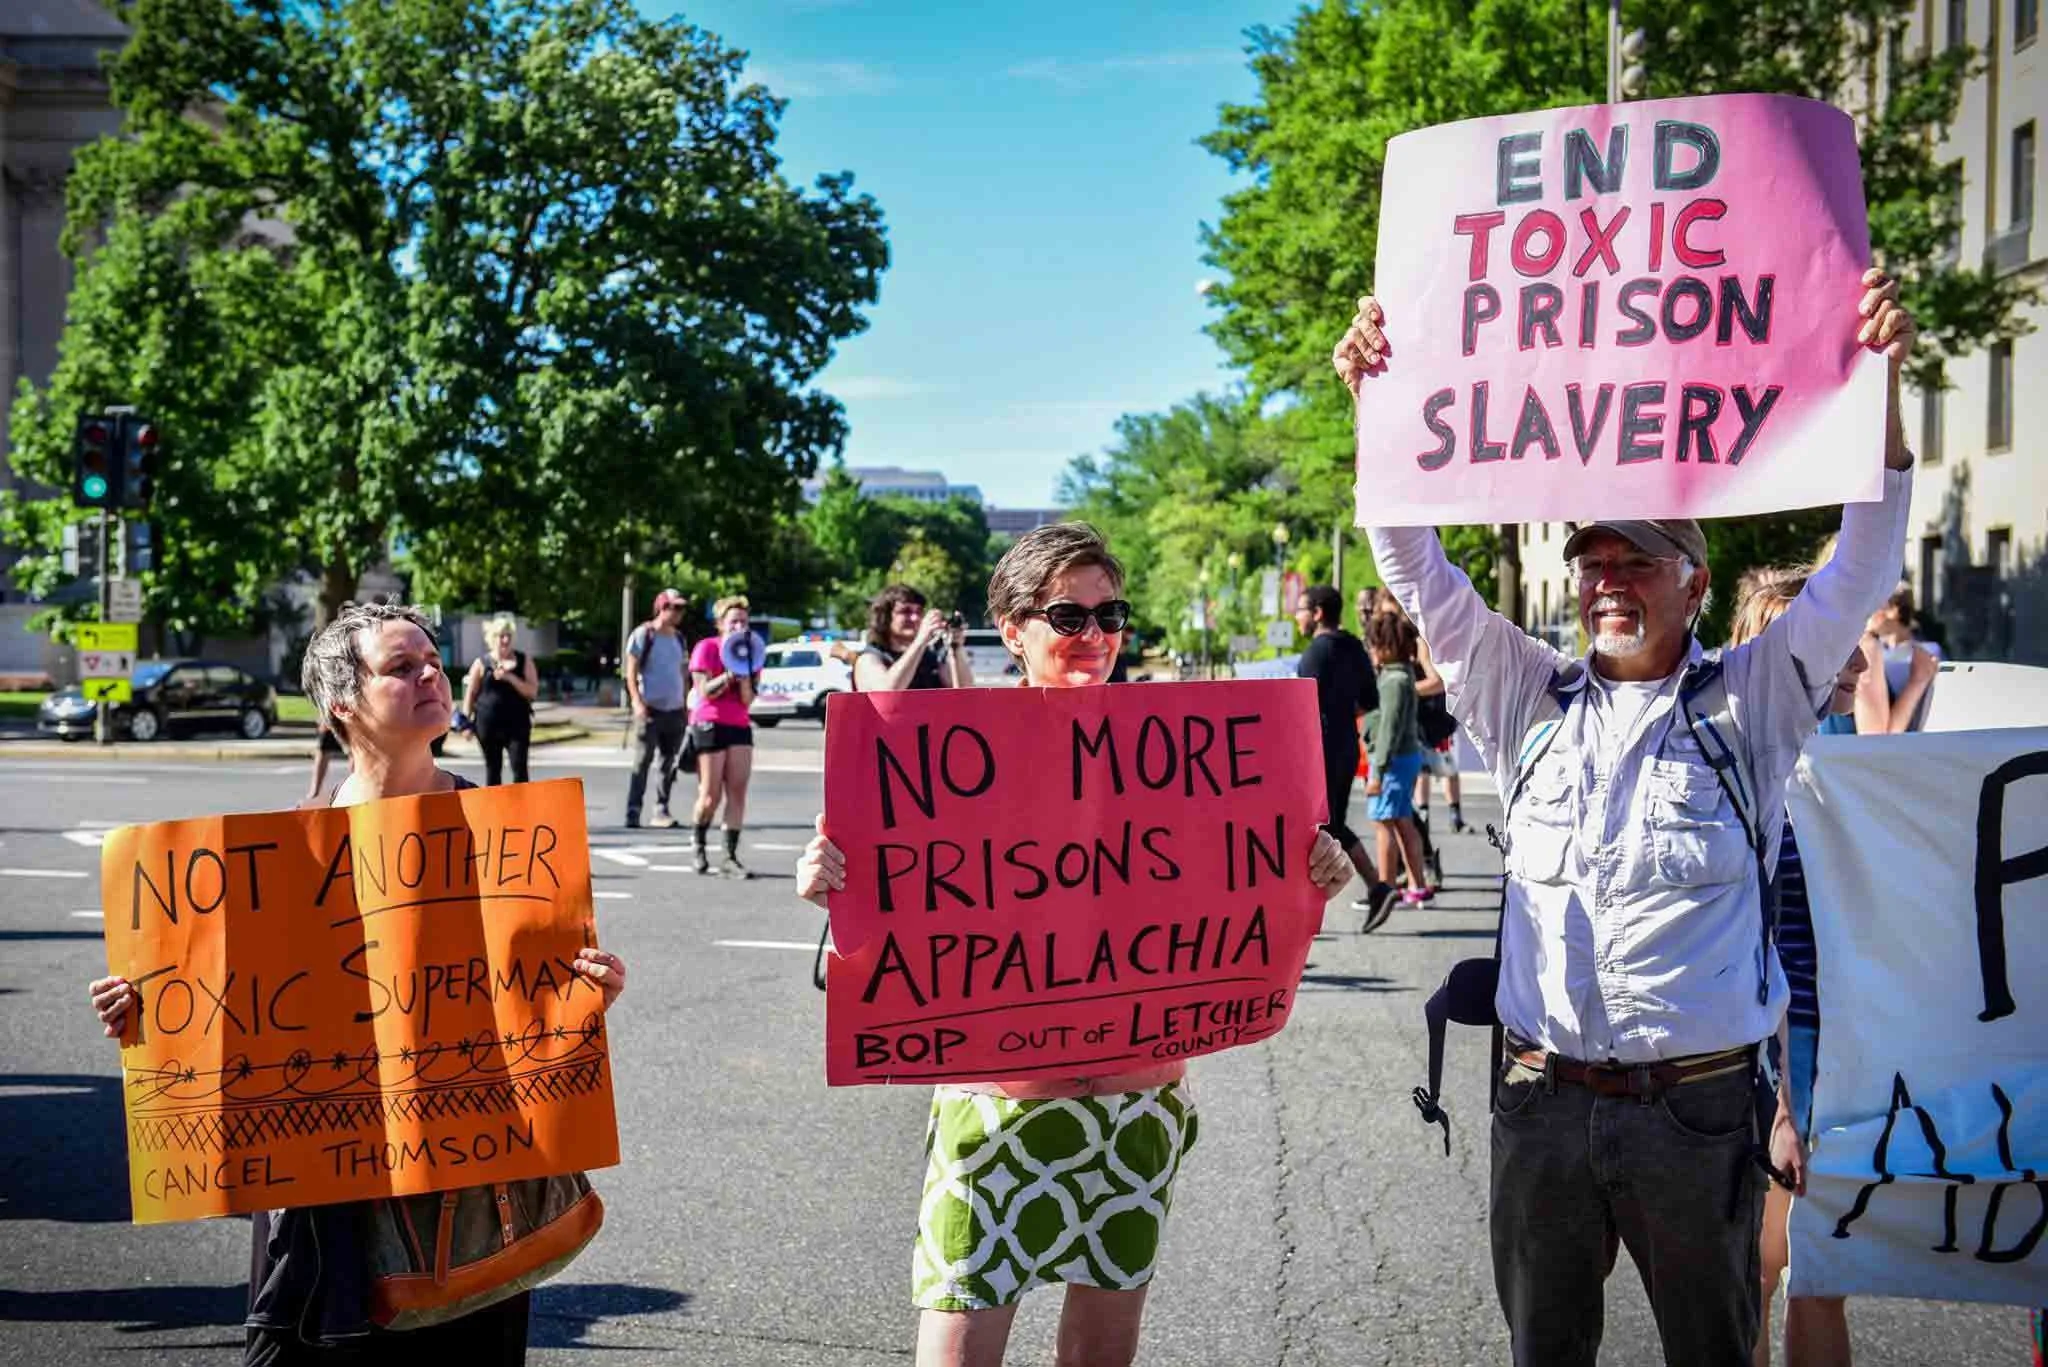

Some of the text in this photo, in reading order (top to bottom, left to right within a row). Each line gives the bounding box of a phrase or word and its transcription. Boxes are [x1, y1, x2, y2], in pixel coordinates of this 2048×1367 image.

[1497, 120, 1720, 205] END
[1454, 198, 1727, 281] TOXIC
[1462, 274, 1776, 357] PRISON
[1417, 381, 1783, 471] SLAVERY
[761, 682, 815, 694] POLICE
[876, 714, 1262, 829] NO MORE
[131, 824, 561, 930] NOT ANOTHER
[875, 814, 1285, 912] PRISONS IN
[861, 904, 1270, 1007] APPALACHIA
[131, 965, 309, 1045] TOXIC
[998, 1026, 1077, 1052] OUT
[1129, 989, 1288, 1046] LETCHER
[1152, 1025, 1250, 1058] COUNTY
[144, 1119, 533, 1200] CANCEL THOMSON
